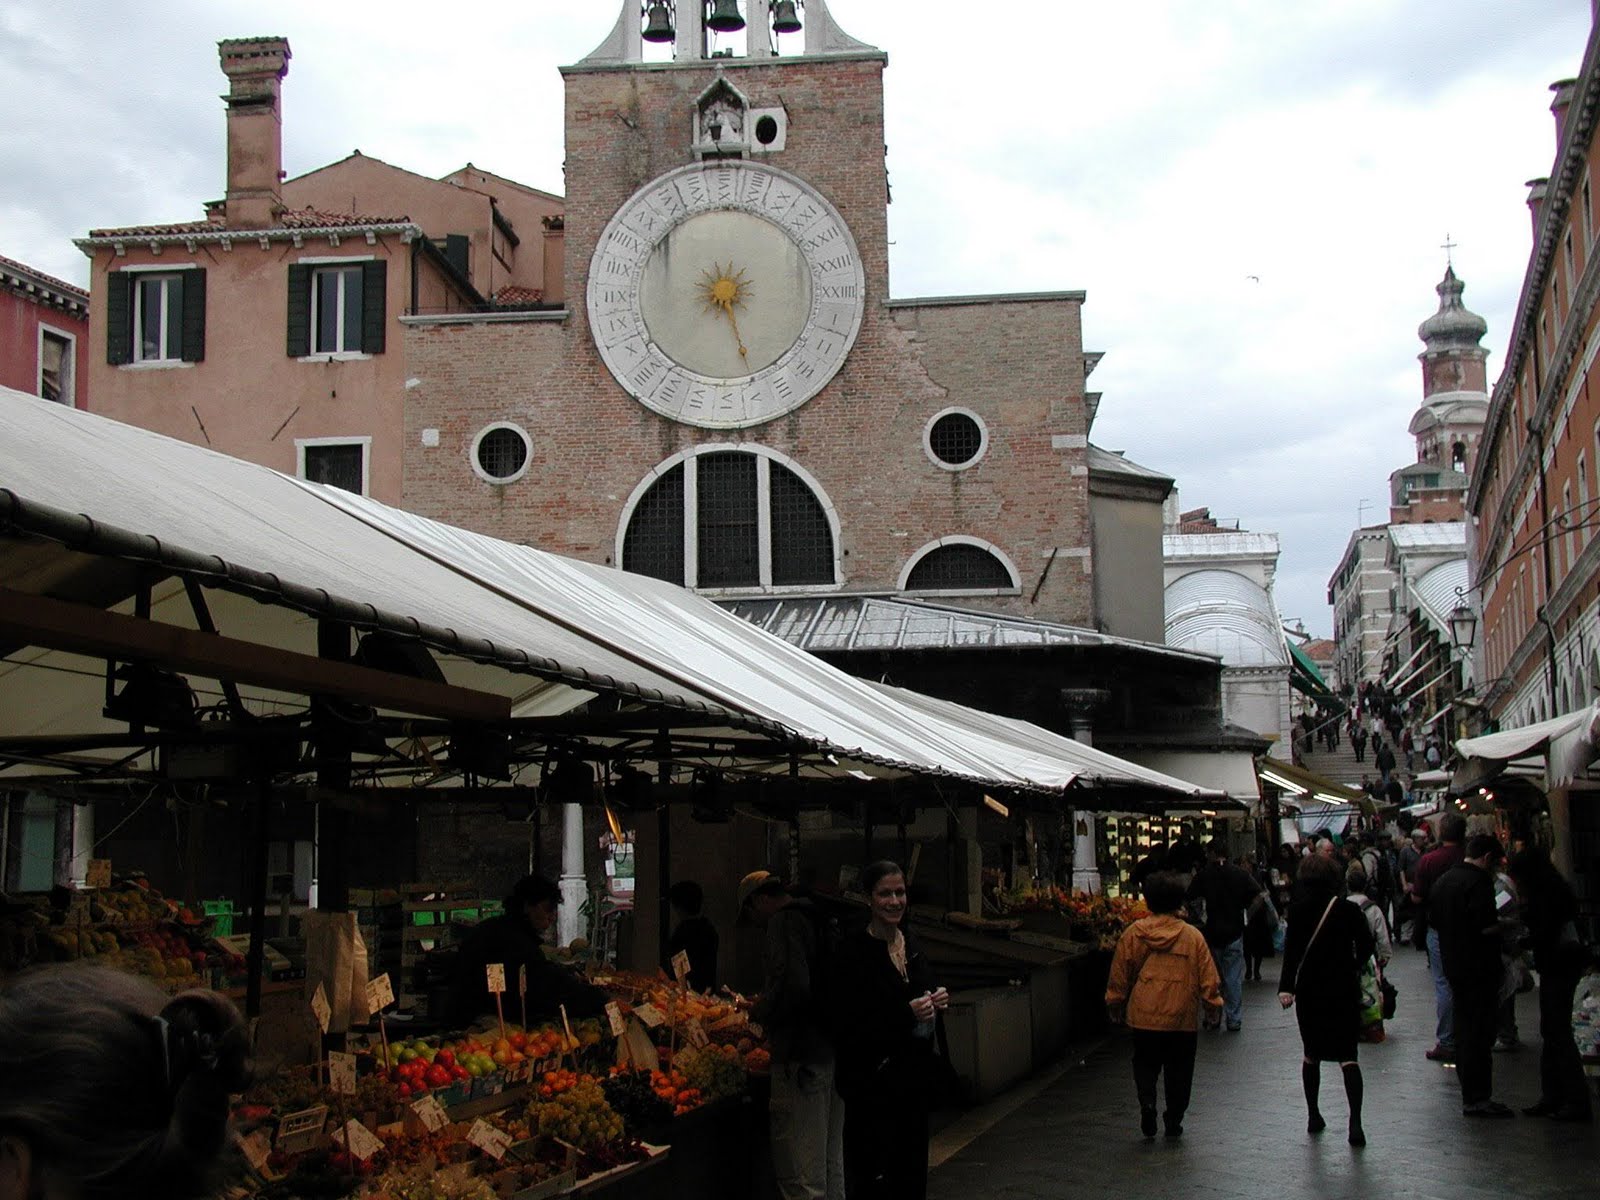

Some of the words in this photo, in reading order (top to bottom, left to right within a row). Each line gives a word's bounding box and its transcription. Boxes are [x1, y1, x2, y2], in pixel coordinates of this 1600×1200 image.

[687, 175, 705, 205] XVII
[658, 189, 681, 216] XVI
[770, 191, 791, 214] XX
[634, 211, 657, 231] XV
[791, 205, 817, 230] XXI
[613, 230, 641, 253] XIIII
[808, 226, 839, 250] XXII
[606, 258, 632, 277] XIII
[818, 254, 851, 274] XXIII
[605, 290, 626, 303] XII
[822, 285, 855, 299] XXIIII
[609, 316, 628, 332] XI
[625, 342, 638, 357] X
[816, 339, 832, 355] II
[634, 361, 662, 386] VIIII
[796, 360, 815, 379] III
[660, 379, 682, 403] VIII
[750, 392, 763, 402] V
[773, 377, 793, 399] IIII
[689, 389, 706, 409] VII
[720, 393, 733, 409] VI
